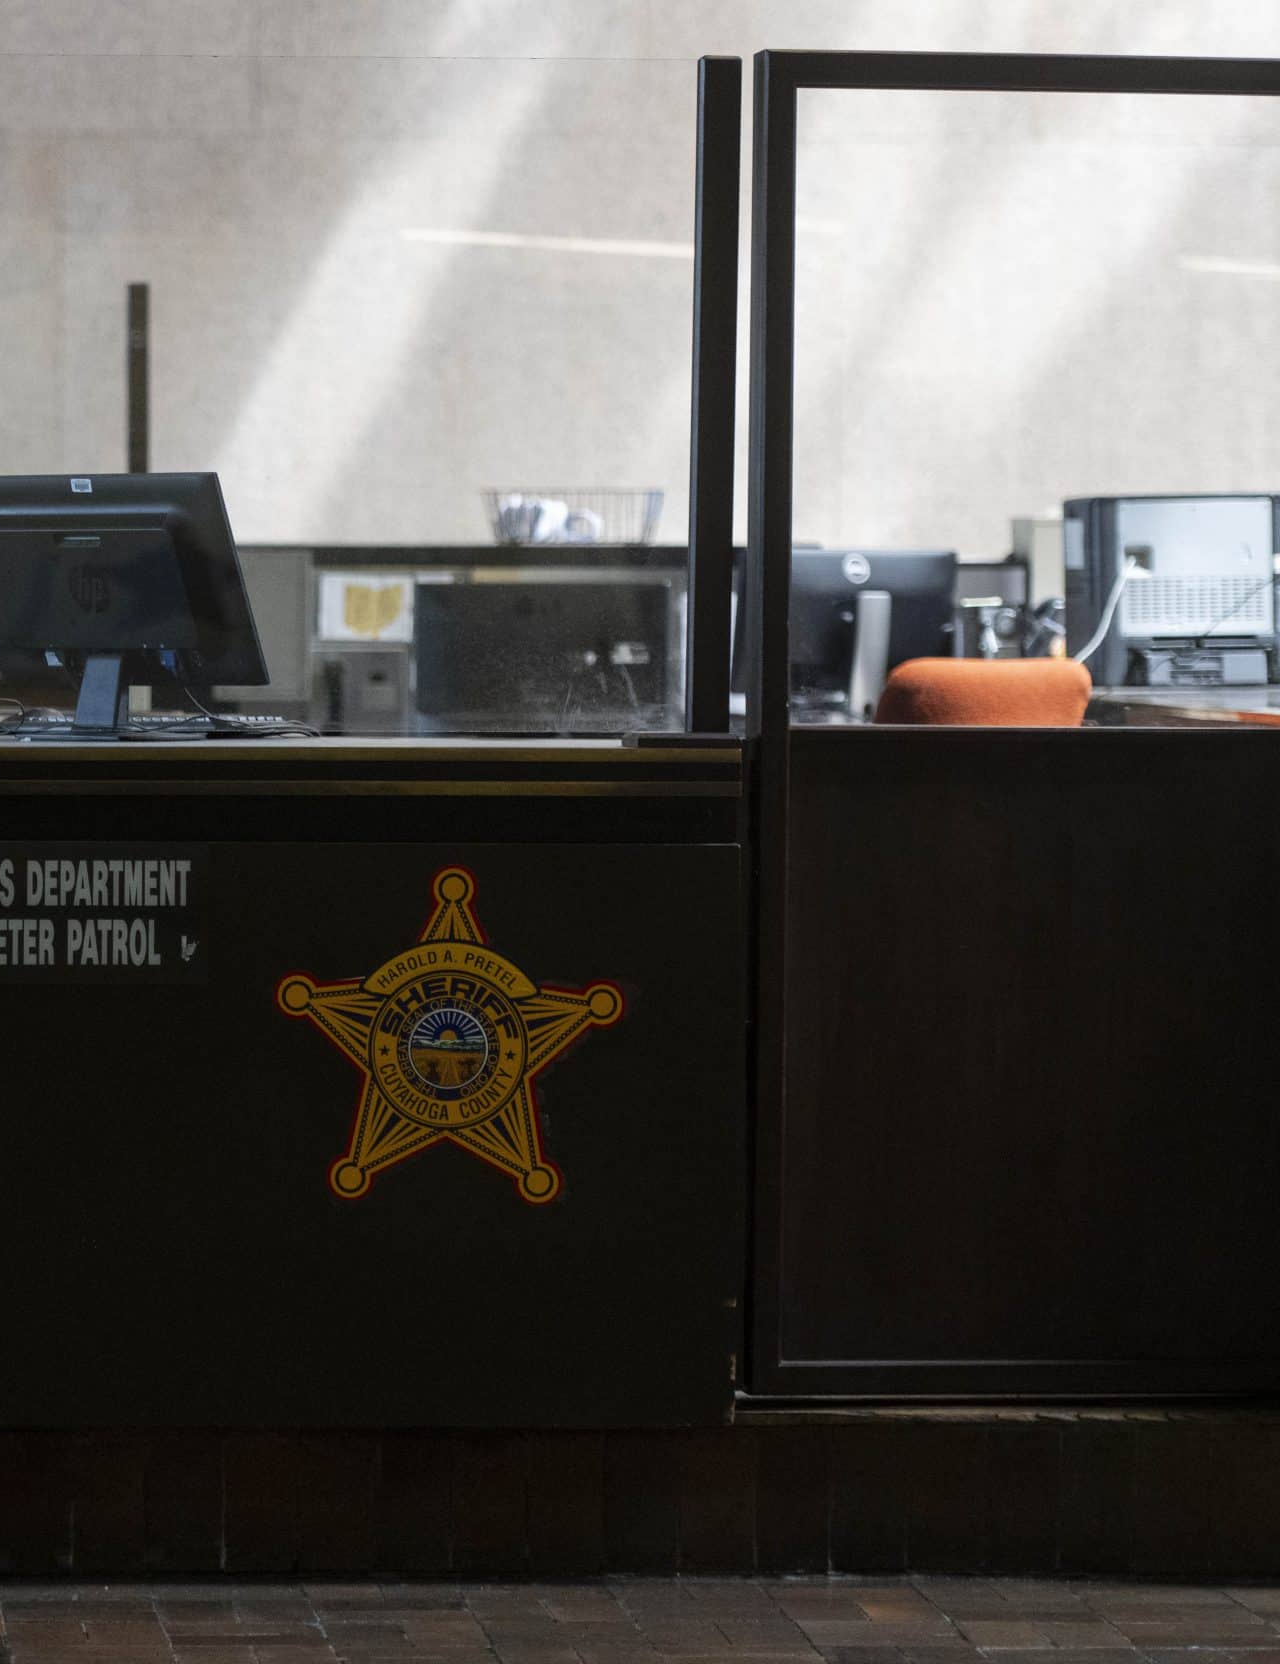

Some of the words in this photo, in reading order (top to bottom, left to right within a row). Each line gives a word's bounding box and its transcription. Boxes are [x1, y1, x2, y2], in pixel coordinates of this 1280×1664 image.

[26, 860, 192, 906] DEPARTMENT
[67, 919, 161, 965] PATROL
[377, 951, 438, 988] HAROLD
[443, 950, 458, 963] A.
[464, 952, 517, 990] PRETEL
[380, 977, 518, 1039] SHERIFF
[430, 999, 446, 1010] OF
[380, 1063, 449, 1121] CUYAHOGA
[459, 1067, 513, 1119] COUNTY
